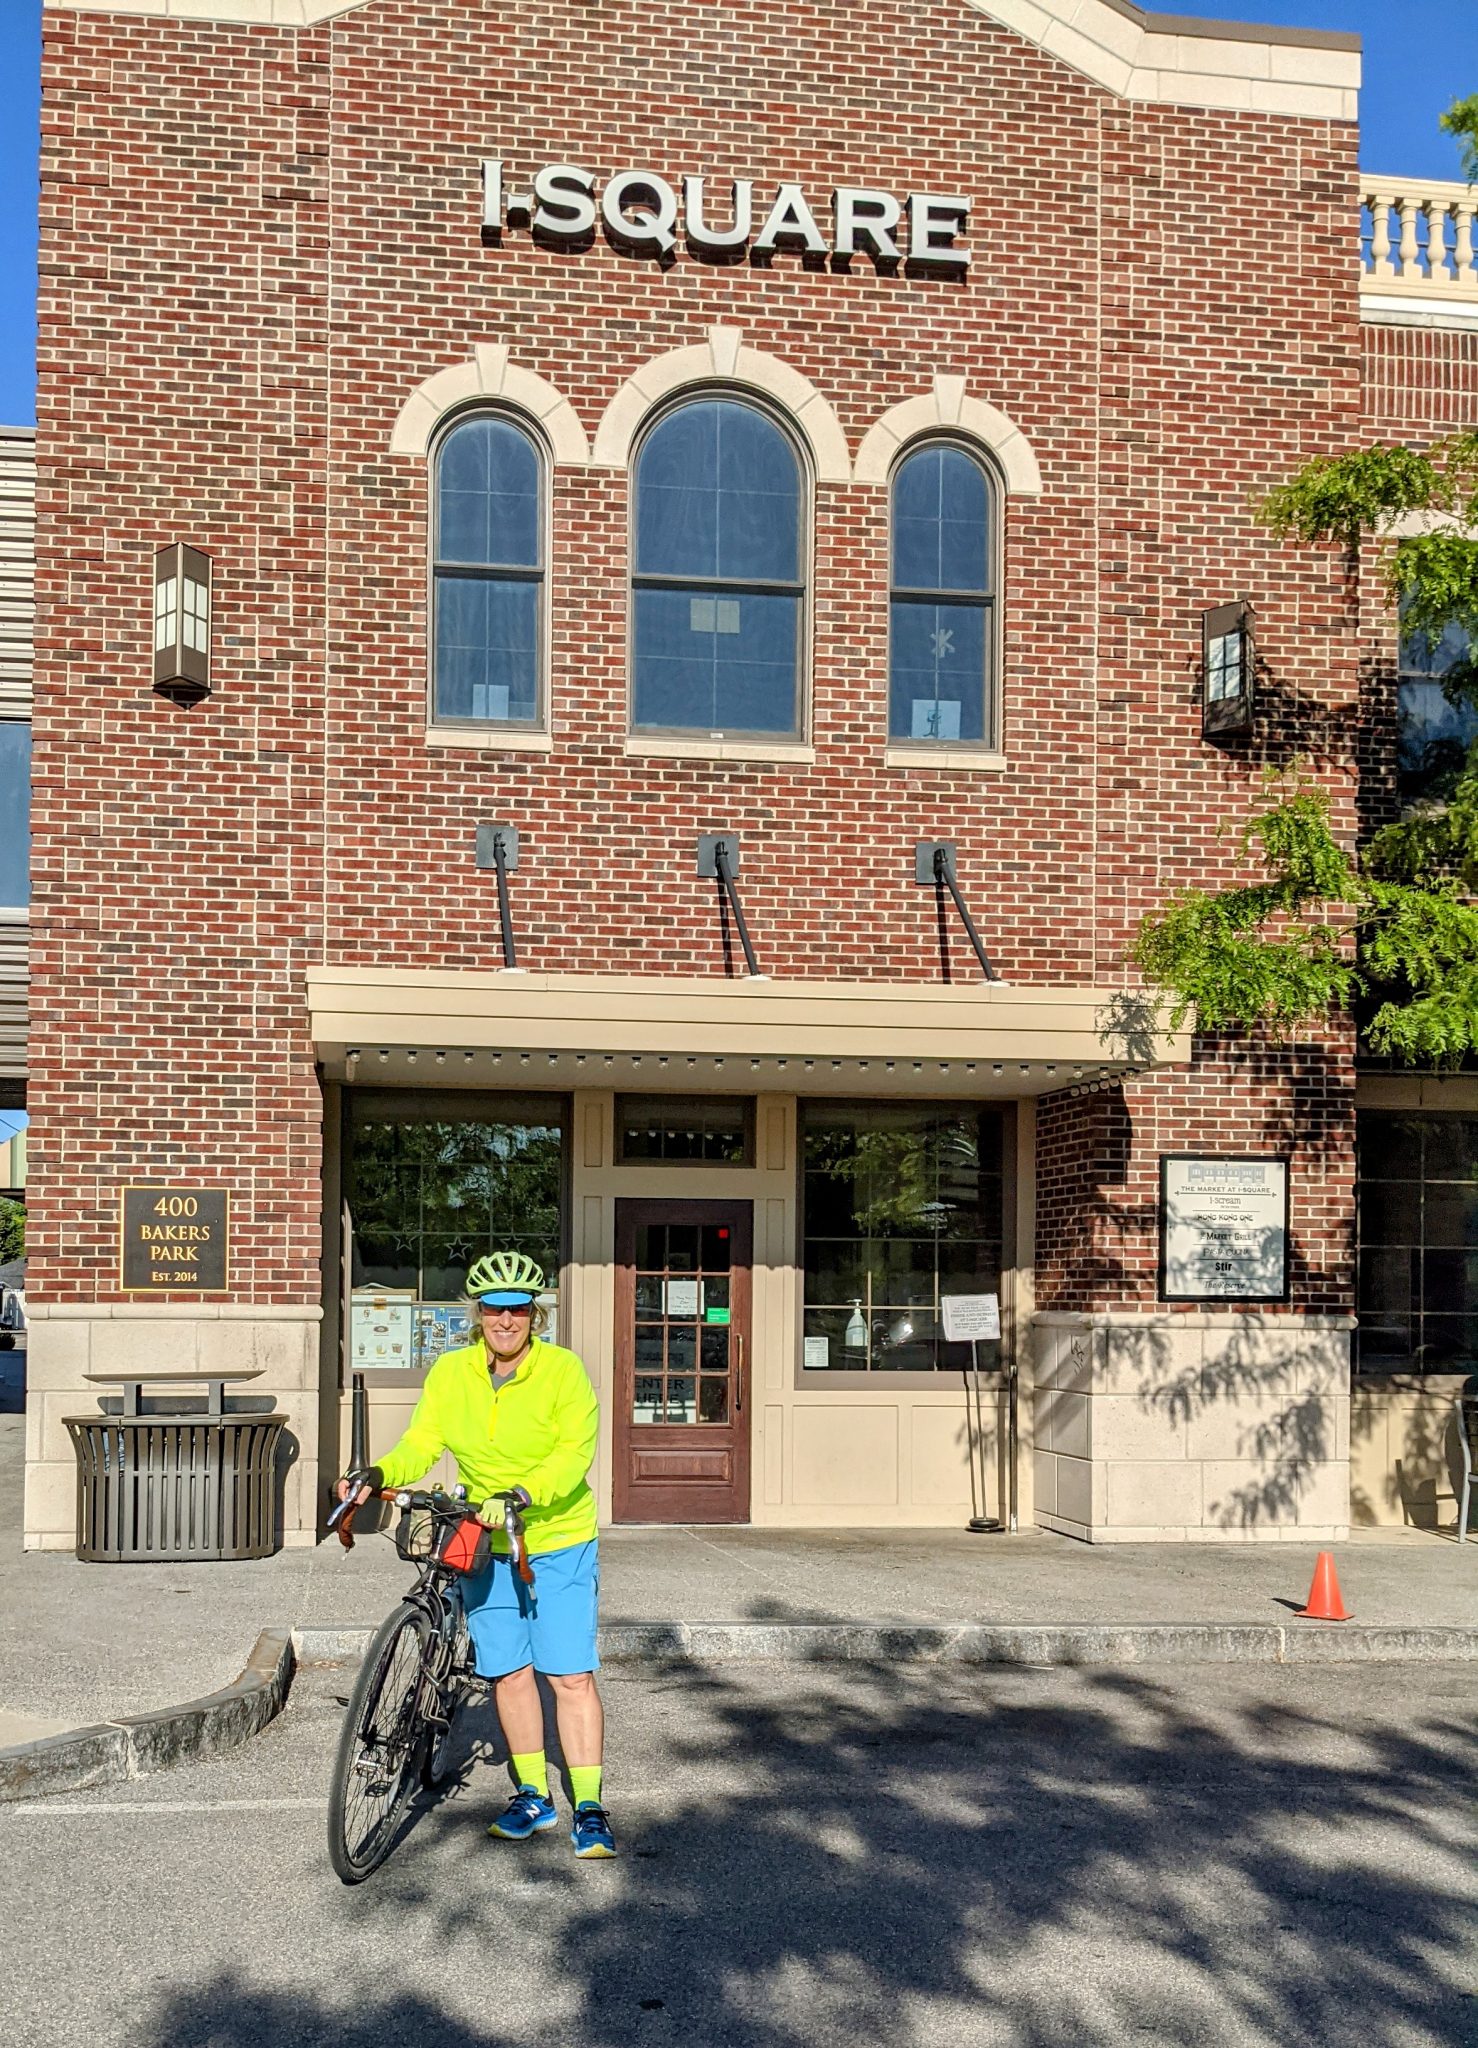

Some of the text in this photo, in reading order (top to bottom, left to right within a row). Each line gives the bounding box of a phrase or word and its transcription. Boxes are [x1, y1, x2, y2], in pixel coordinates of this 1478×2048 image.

[481, 160, 972, 266] I-SQUARE
[154, 1196, 198, 1217] 400
[1218, 1214, 1238, 1222] KONG
[140, 1225, 210, 1241] BAKERS
[150, 1246, 200, 1261] PARK
[1215, 1262, 1232, 1271] Stir
[174, 1272, 198, 1282] 2014
[634, 1378, 685, 1390] ENTER
[526, 1804, 541, 1819] N
